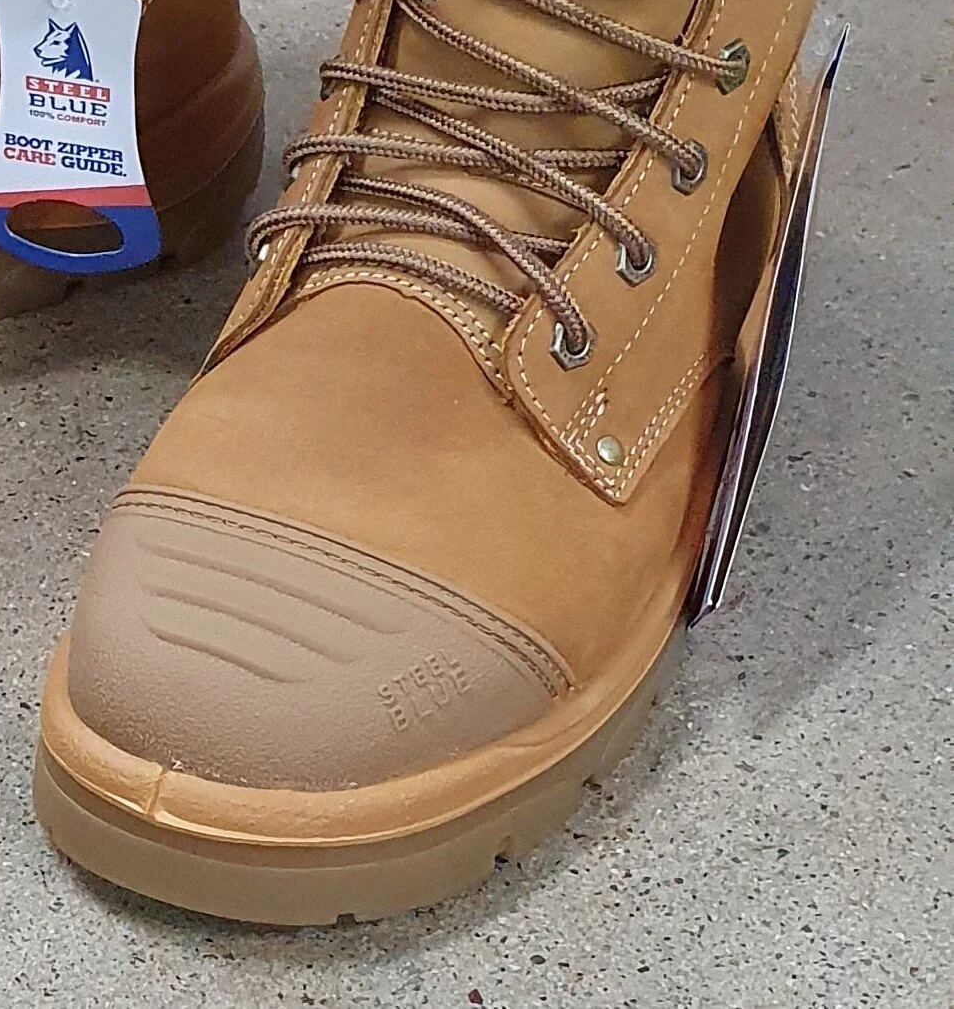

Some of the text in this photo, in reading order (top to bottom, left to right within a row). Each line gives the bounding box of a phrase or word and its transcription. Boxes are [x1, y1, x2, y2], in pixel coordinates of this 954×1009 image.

[28, 78, 108, 101] STEEL
[29, 93, 108, 118] BLUE
[29, 109, 107, 127] 100% COMFORT
[3, 147, 127, 178] CARE GUIDE.
[4, 133, 124, 163] BOOT ZIPPER
[377, 650, 461, 709] STEEL
[387, 668, 472, 732] BLUE
